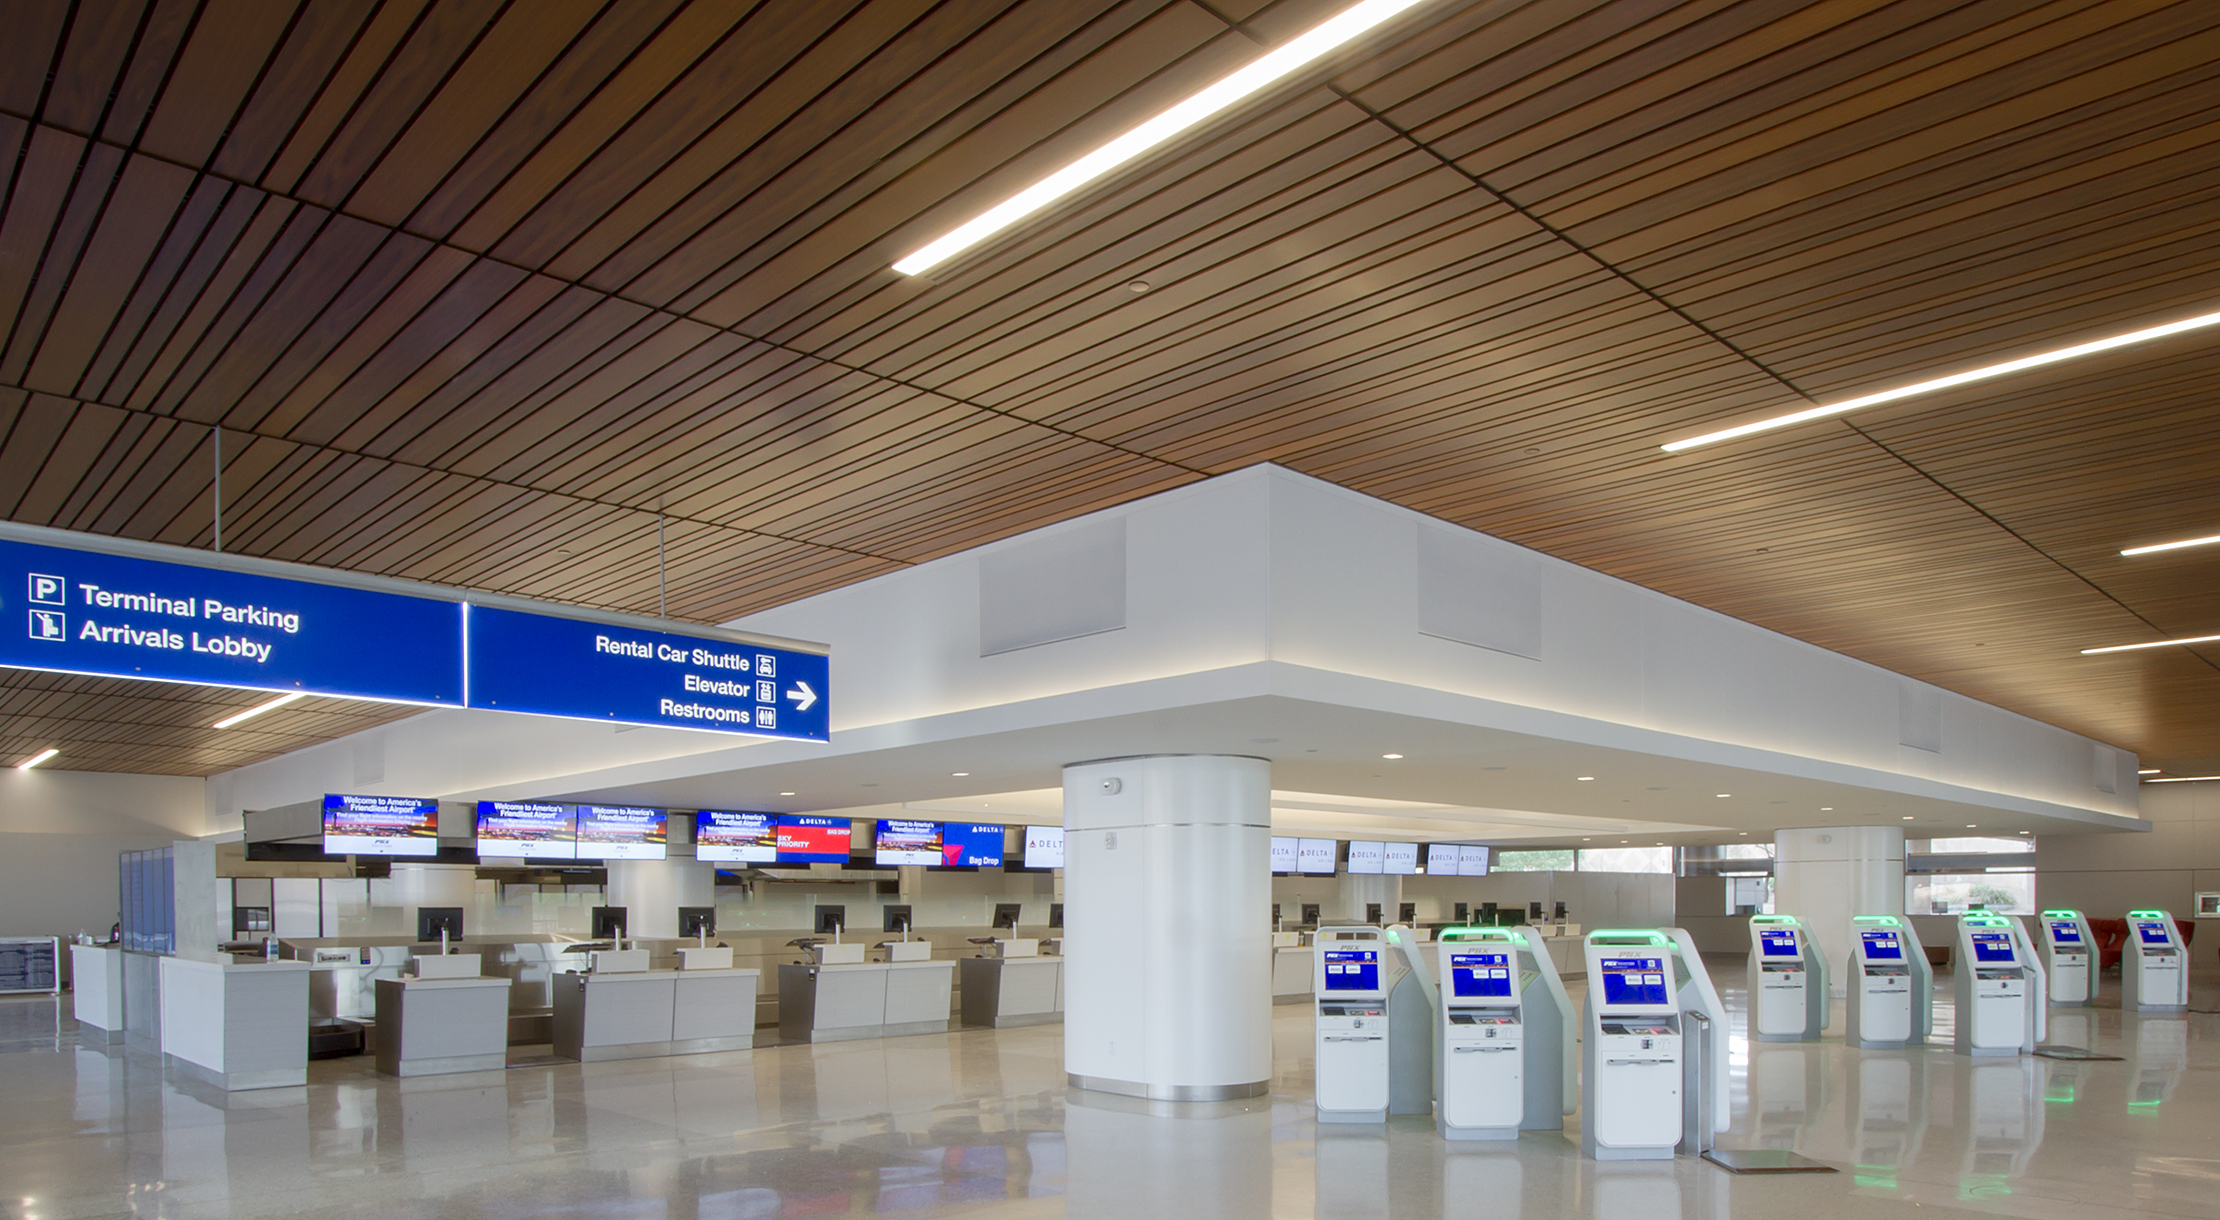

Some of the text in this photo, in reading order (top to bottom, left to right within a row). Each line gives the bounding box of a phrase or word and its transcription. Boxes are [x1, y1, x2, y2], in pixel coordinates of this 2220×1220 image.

[79, 584, 299, 633] Terminal Parking
[79, 620, 271, 663] Arrivals Lobby
[596, 635, 750, 671] Rental Car Shuttle
[685, 675, 750, 697] Elevator
[661, 699, 750, 724] Restrooms
[343, 796, 377, 805] Welcome
[387, 798, 422, 807] America's
[350, 804, 415, 814] Friendliest Airport
[494, 802, 524, 810] Welcome
[532, 804, 563, 812] America's
[534, 811, 557, 819] Airport
[626, 808, 654, 817] America's
[1039, 840, 1063, 848] DELT
[969, 856, 999, 866] Bag Drop
